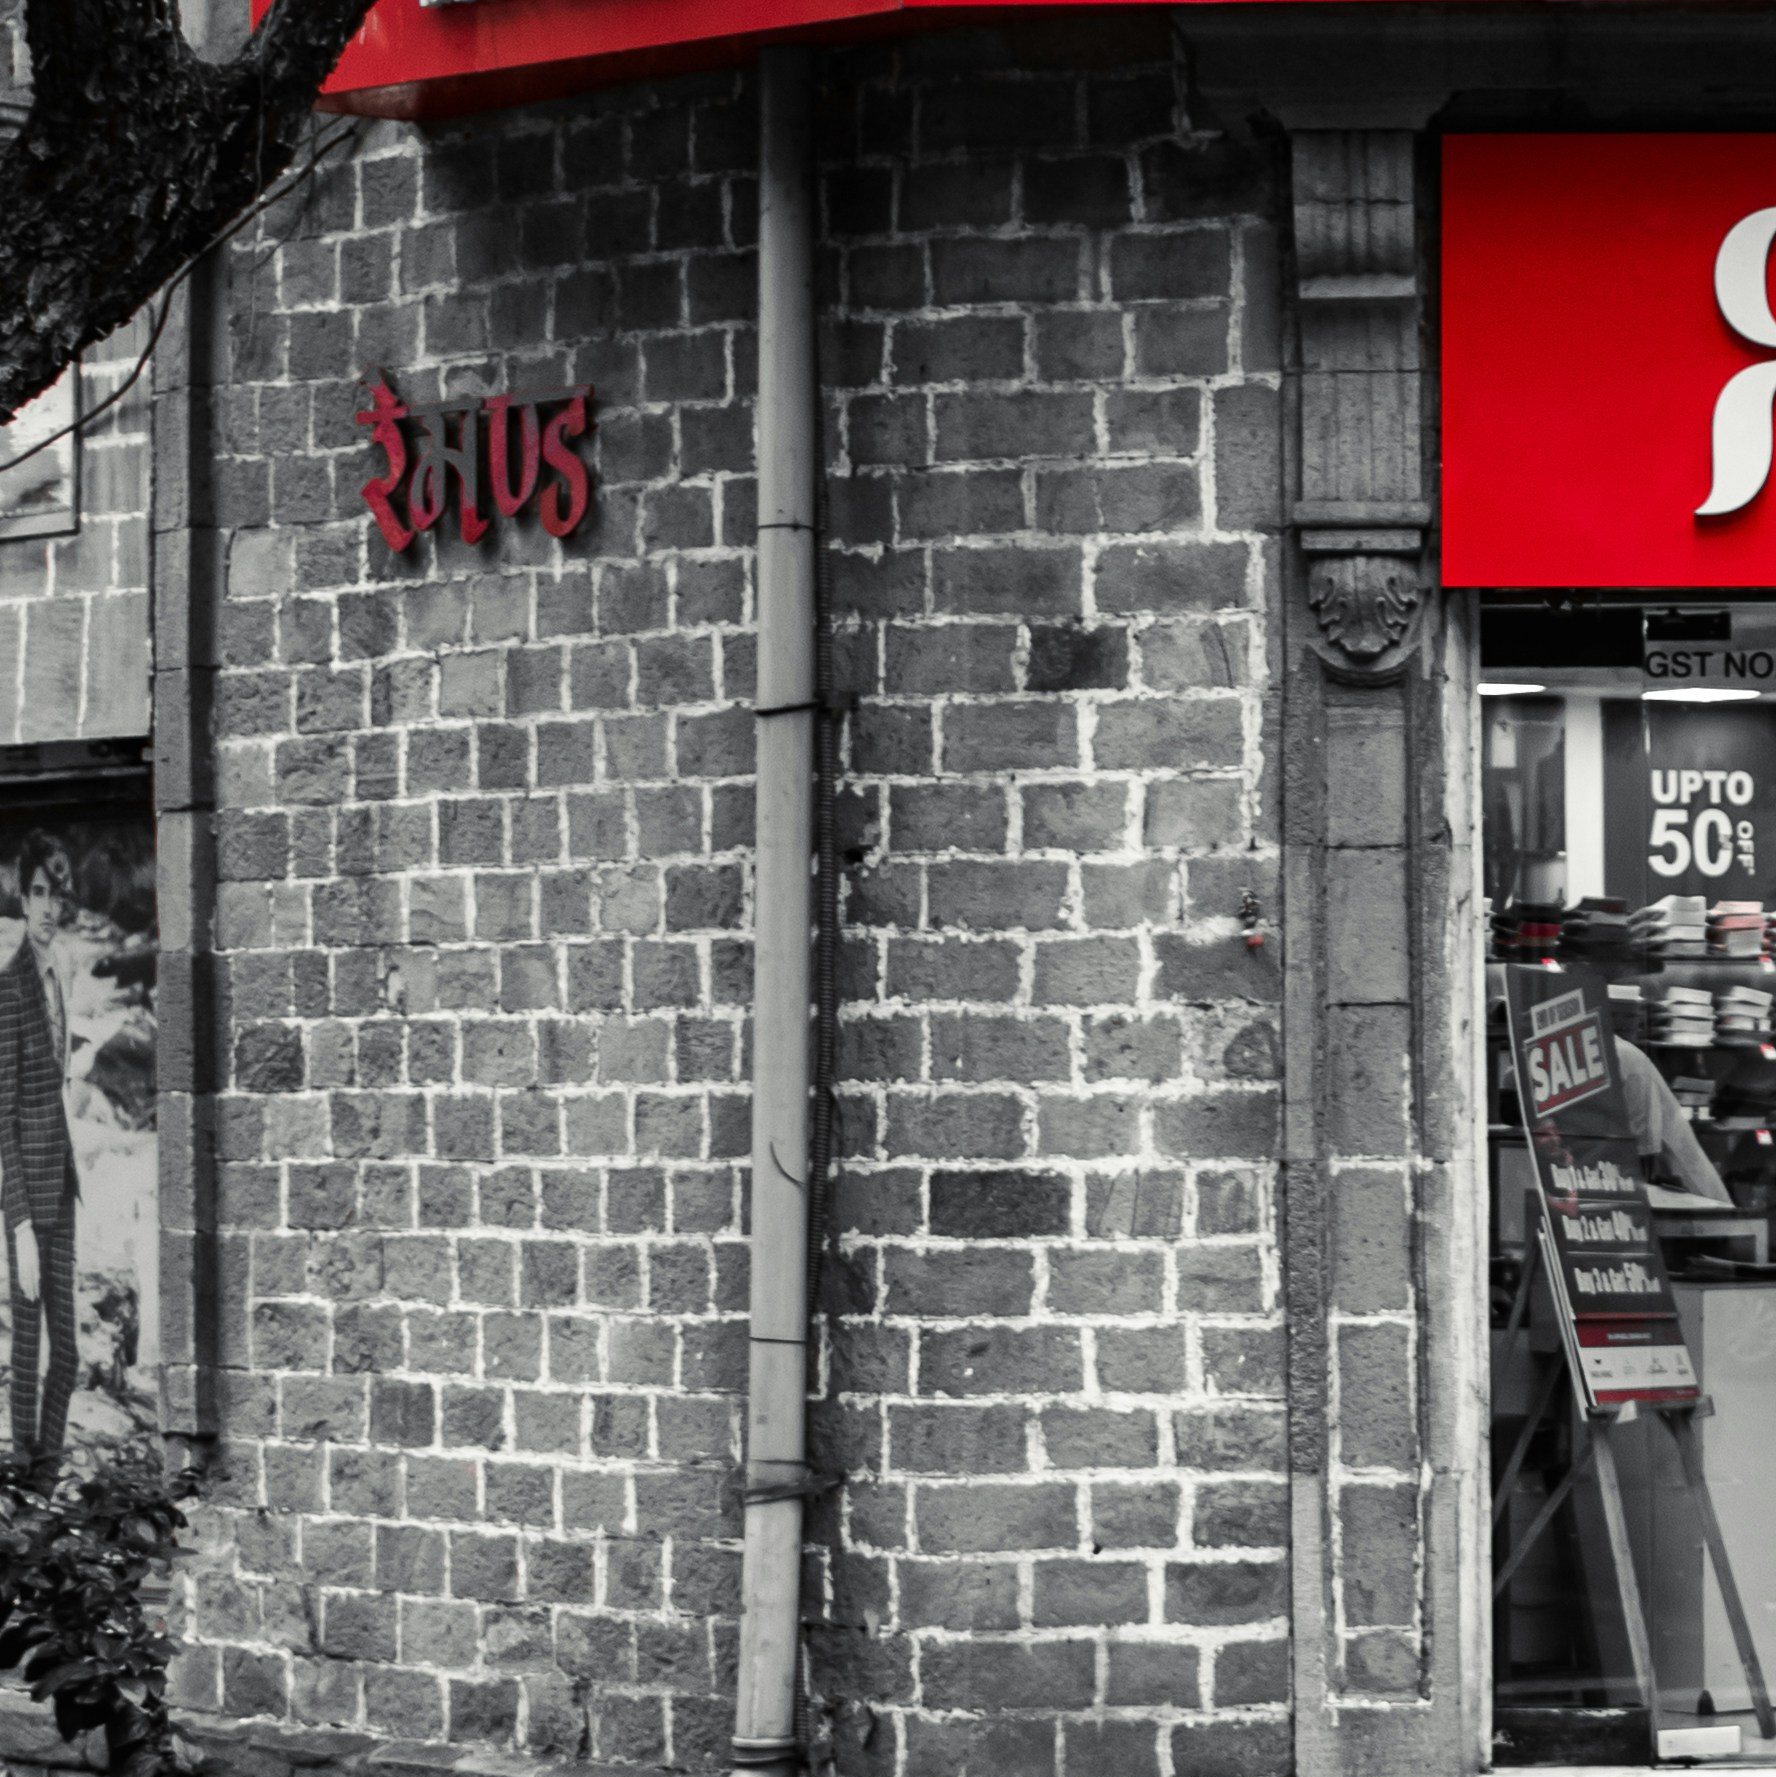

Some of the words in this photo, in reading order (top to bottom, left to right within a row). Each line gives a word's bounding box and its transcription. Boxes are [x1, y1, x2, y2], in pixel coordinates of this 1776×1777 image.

[1645, 651, 1714, 678] GST
[1650, 769, 1755, 806] UPTO
[1528, 1024, 1606, 1103] SALE
